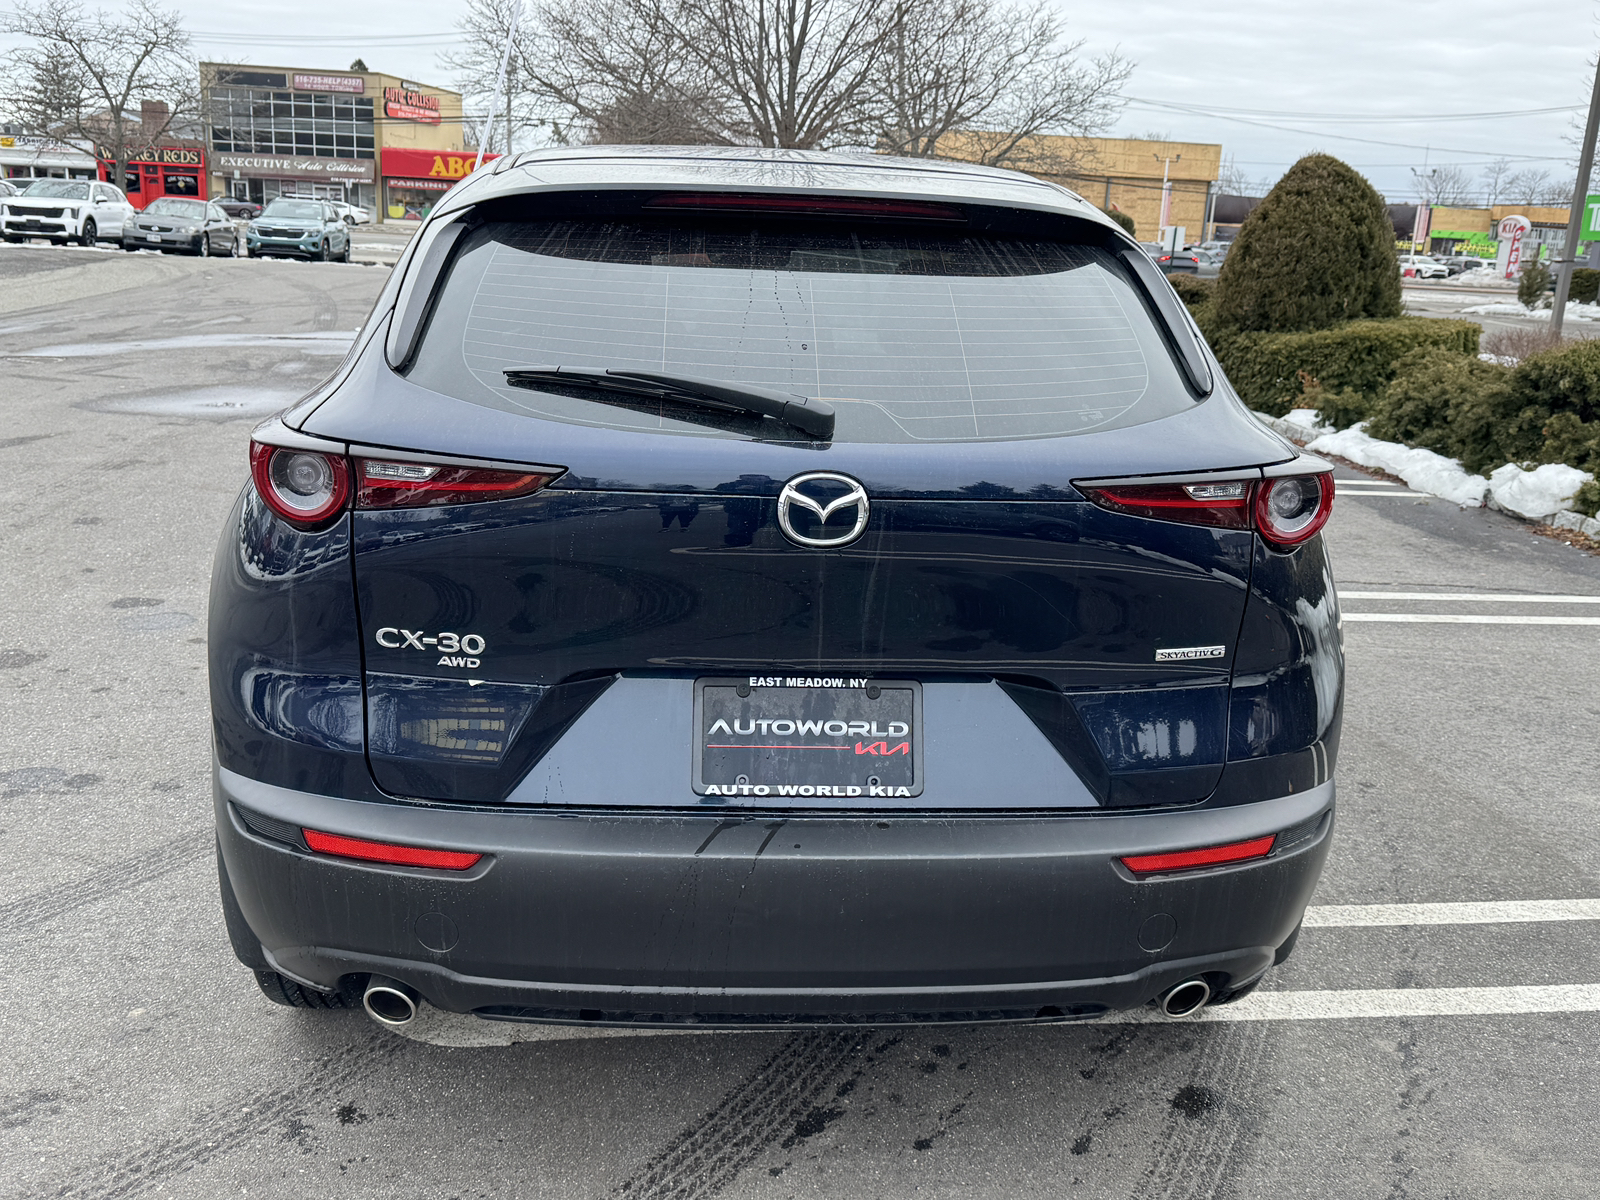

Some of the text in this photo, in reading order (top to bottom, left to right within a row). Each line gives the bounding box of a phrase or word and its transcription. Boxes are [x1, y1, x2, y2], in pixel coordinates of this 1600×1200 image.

[384, 87, 404, 103] AUTO
[407, 91, 440, 110] COLLISION
[163, 149, 199, 164] REDS
[220, 156, 366, 173] EXECUTIVE Auto Collision
[389, 179, 448, 189] PARKING
[375, 627, 486, 655] CX-30
[437, 655, 481, 668] AWD
[749, 677, 783, 687] EAST
[849, 678, 868, 689] NY
[707, 718, 909, 738] AUTOWORLD
[855, 741, 910, 756] KIA
[704, 784, 911, 797] AUTO WORLD KIA
